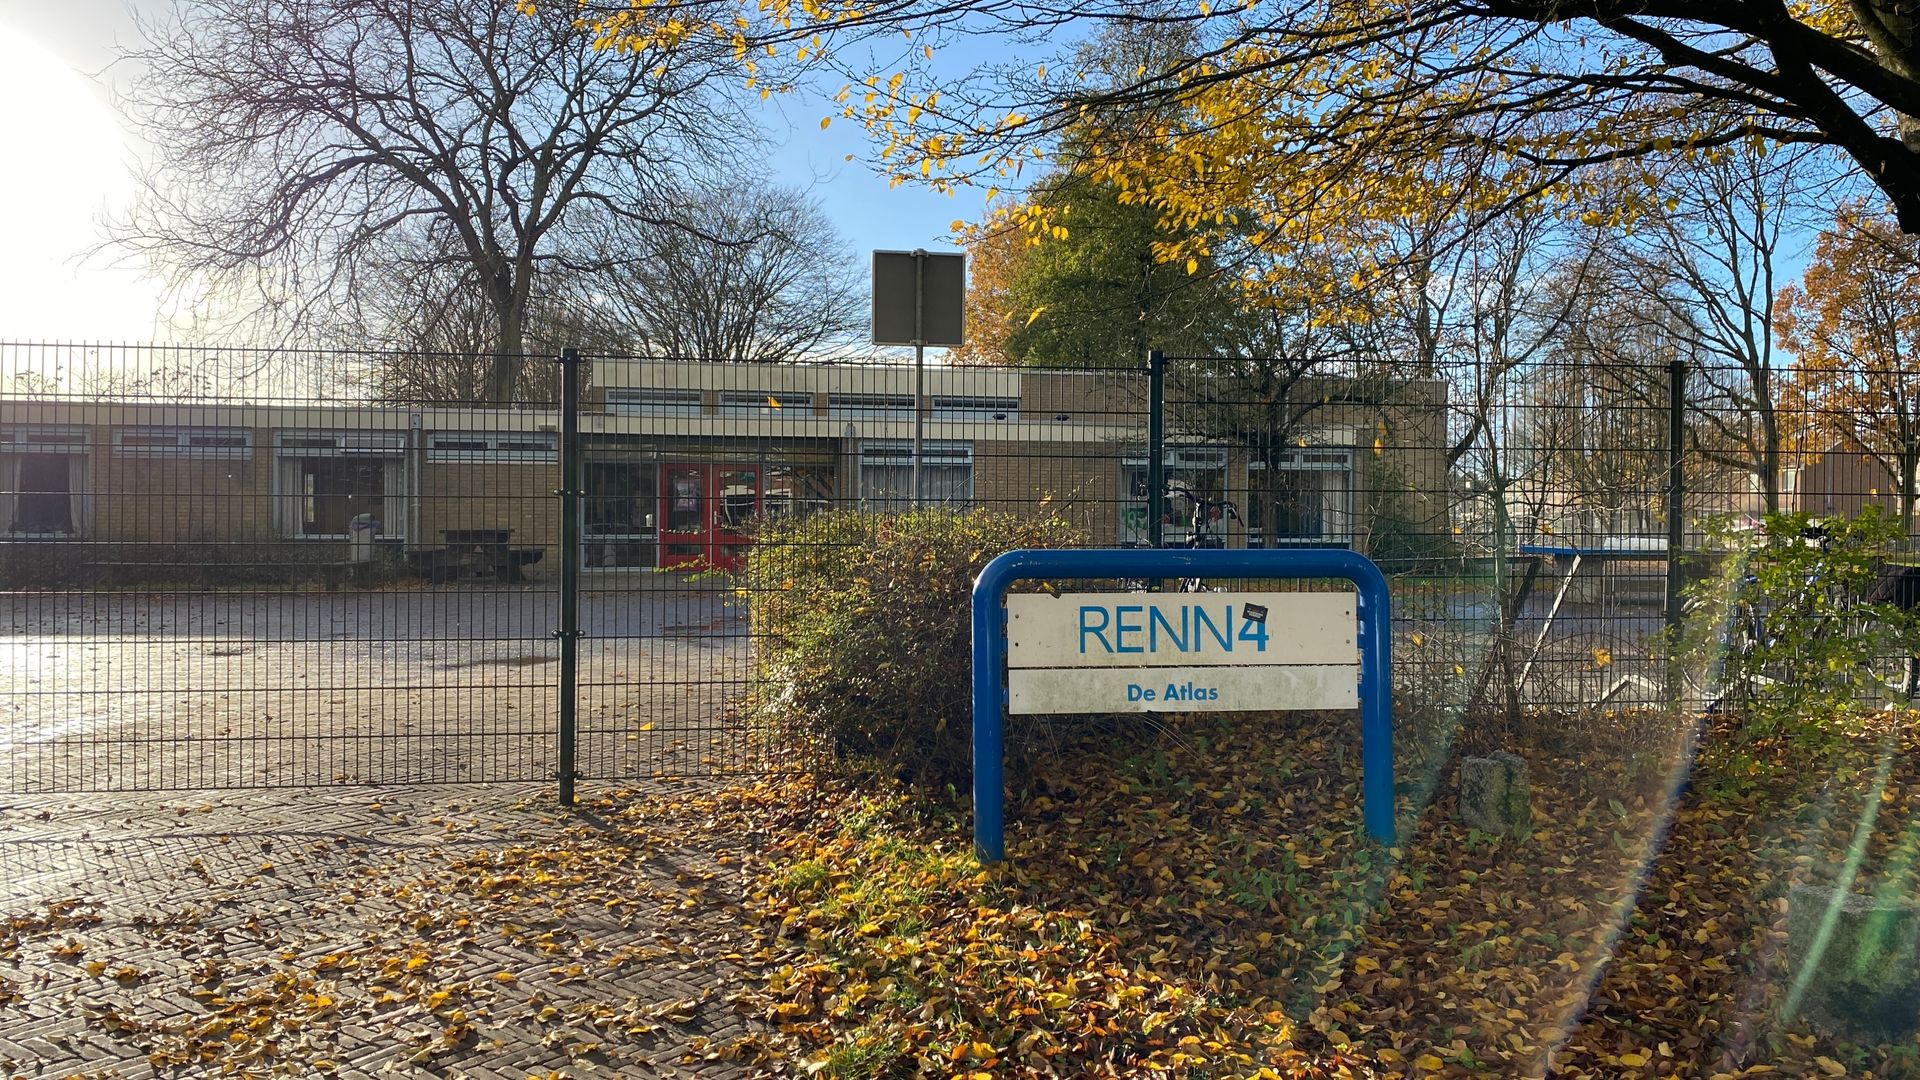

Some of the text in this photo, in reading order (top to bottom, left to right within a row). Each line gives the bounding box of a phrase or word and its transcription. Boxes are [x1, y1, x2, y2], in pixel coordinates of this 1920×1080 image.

[1079, 604, 1269, 653] RENN4
[1127, 682, 1218, 702] De Atlas
